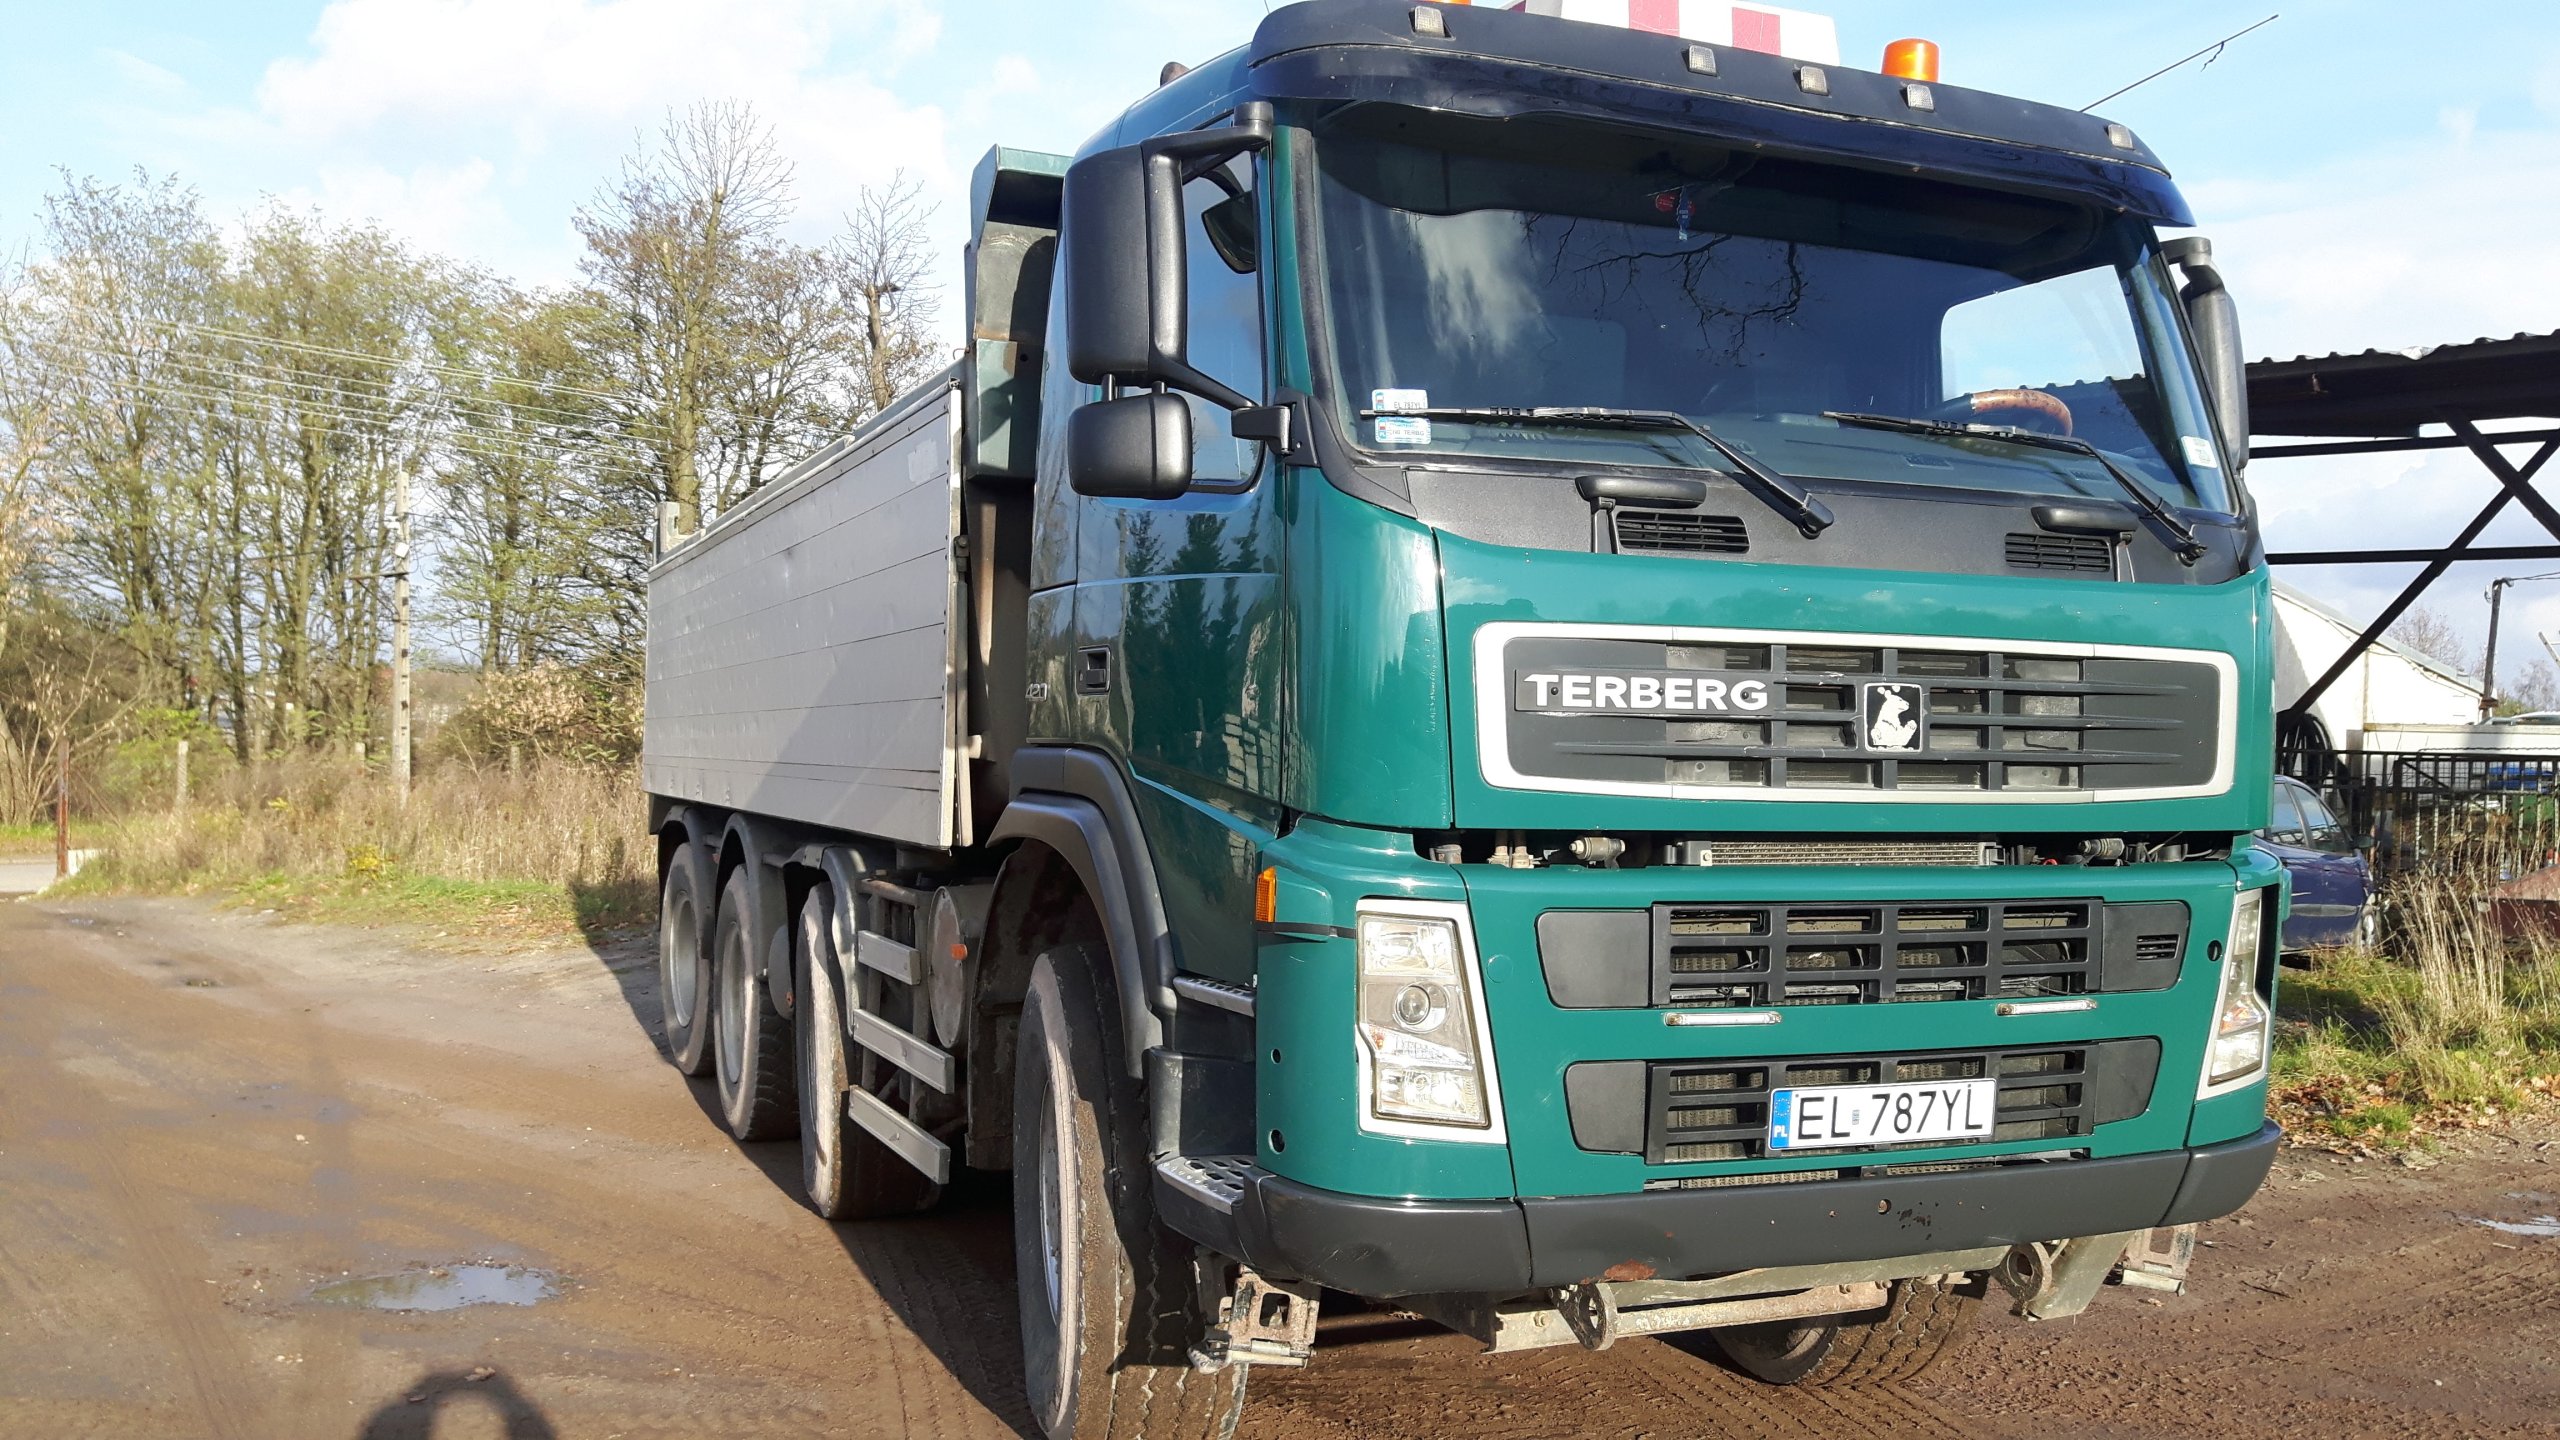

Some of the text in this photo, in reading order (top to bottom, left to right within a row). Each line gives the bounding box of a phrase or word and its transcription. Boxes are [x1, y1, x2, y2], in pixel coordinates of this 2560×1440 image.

[1523, 673, 1769, 711] TERBERG
[1773, 1125, 1788, 1138] PL
[1797, 1087, 1983, 1140] EL 787YL
